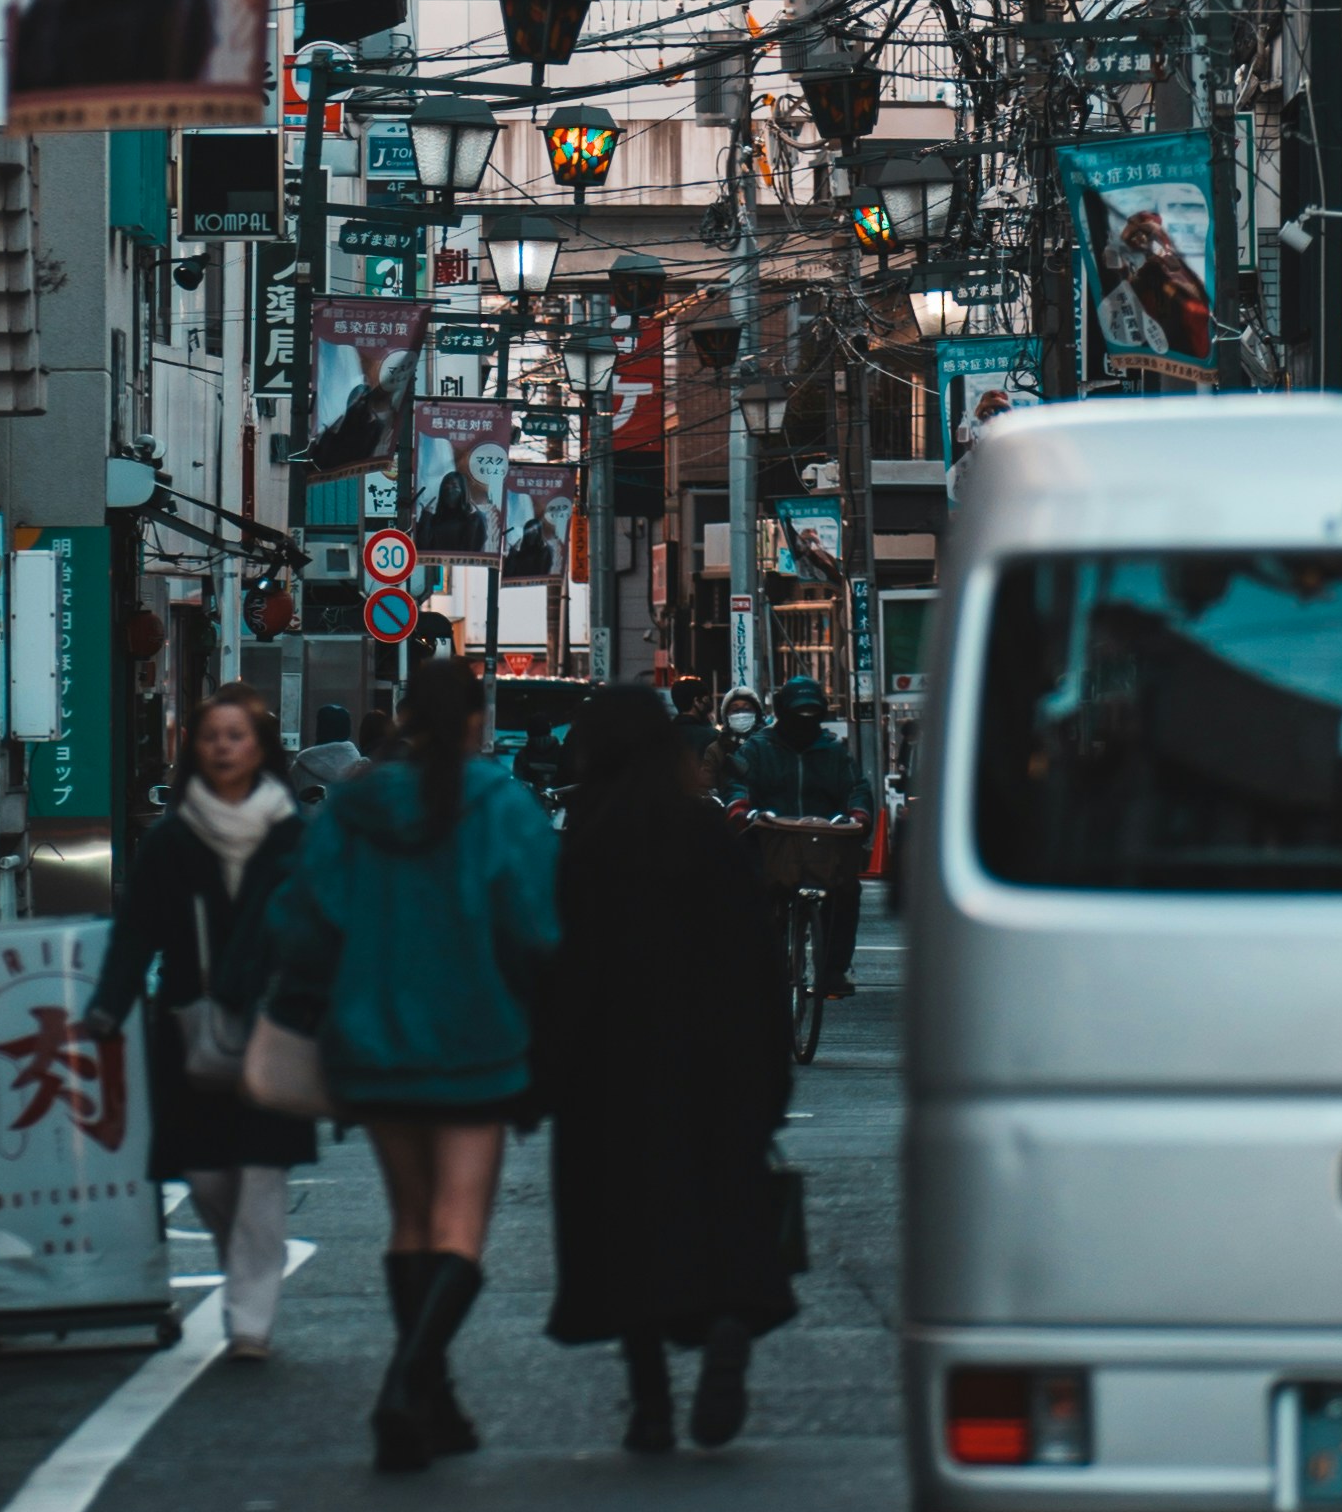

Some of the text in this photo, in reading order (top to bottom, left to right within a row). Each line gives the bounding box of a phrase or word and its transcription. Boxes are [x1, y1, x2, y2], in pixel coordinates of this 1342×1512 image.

[1085, 53, 1169, 73] あずま通り
[387, 182, 406, 192] 4F
[194, 213, 271, 232] KOMPAL
[345, 230, 411, 249] あずま通り
[957, 282, 1016, 298] あずま通り
[333, 320, 408, 336] 感染症対策
[441, 332, 495, 348] あずま通り
[943, 356, 1009, 372] 感染症対策
[431, 418, 493, 432] 感染症対策
[476, 454, 504, 465] マスク
[373, 498, 398, 513] ドー
[375, 544, 406, 569] 30
[736, 613, 748, 686] ISUZUYA
